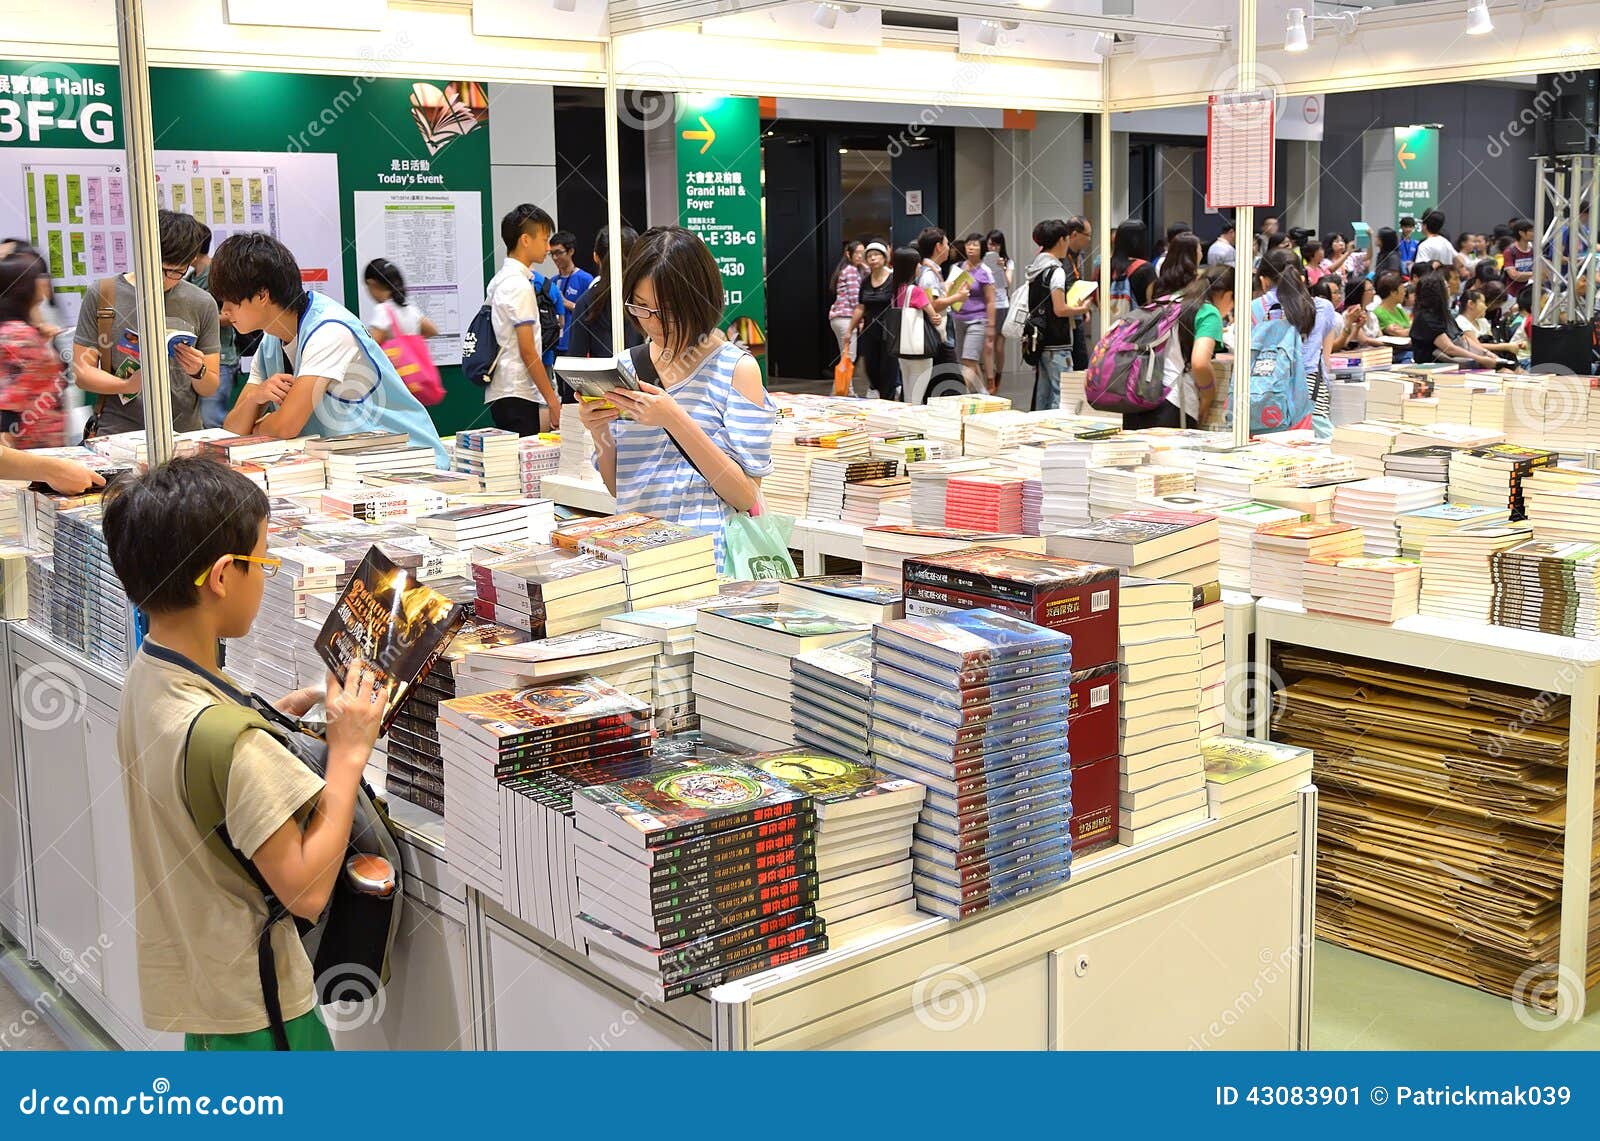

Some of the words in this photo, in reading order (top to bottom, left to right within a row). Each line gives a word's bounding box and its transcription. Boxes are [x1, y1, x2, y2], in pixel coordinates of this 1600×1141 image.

[56, 78, 105, 96] Halls
[0, 99, 114, 144] 3F-G
[391, 160, 430, 171] 是日活動
[377, 173, 414, 186] Today's
[417, 173, 444, 184] Event
[686, 171, 742, 184] 大會堂及前廳
[686, 185, 715, 196] Grand
[717, 185, 736, 196] Hall
[738, 186, 746, 196] &
[686, 198, 714, 211] Foyer
